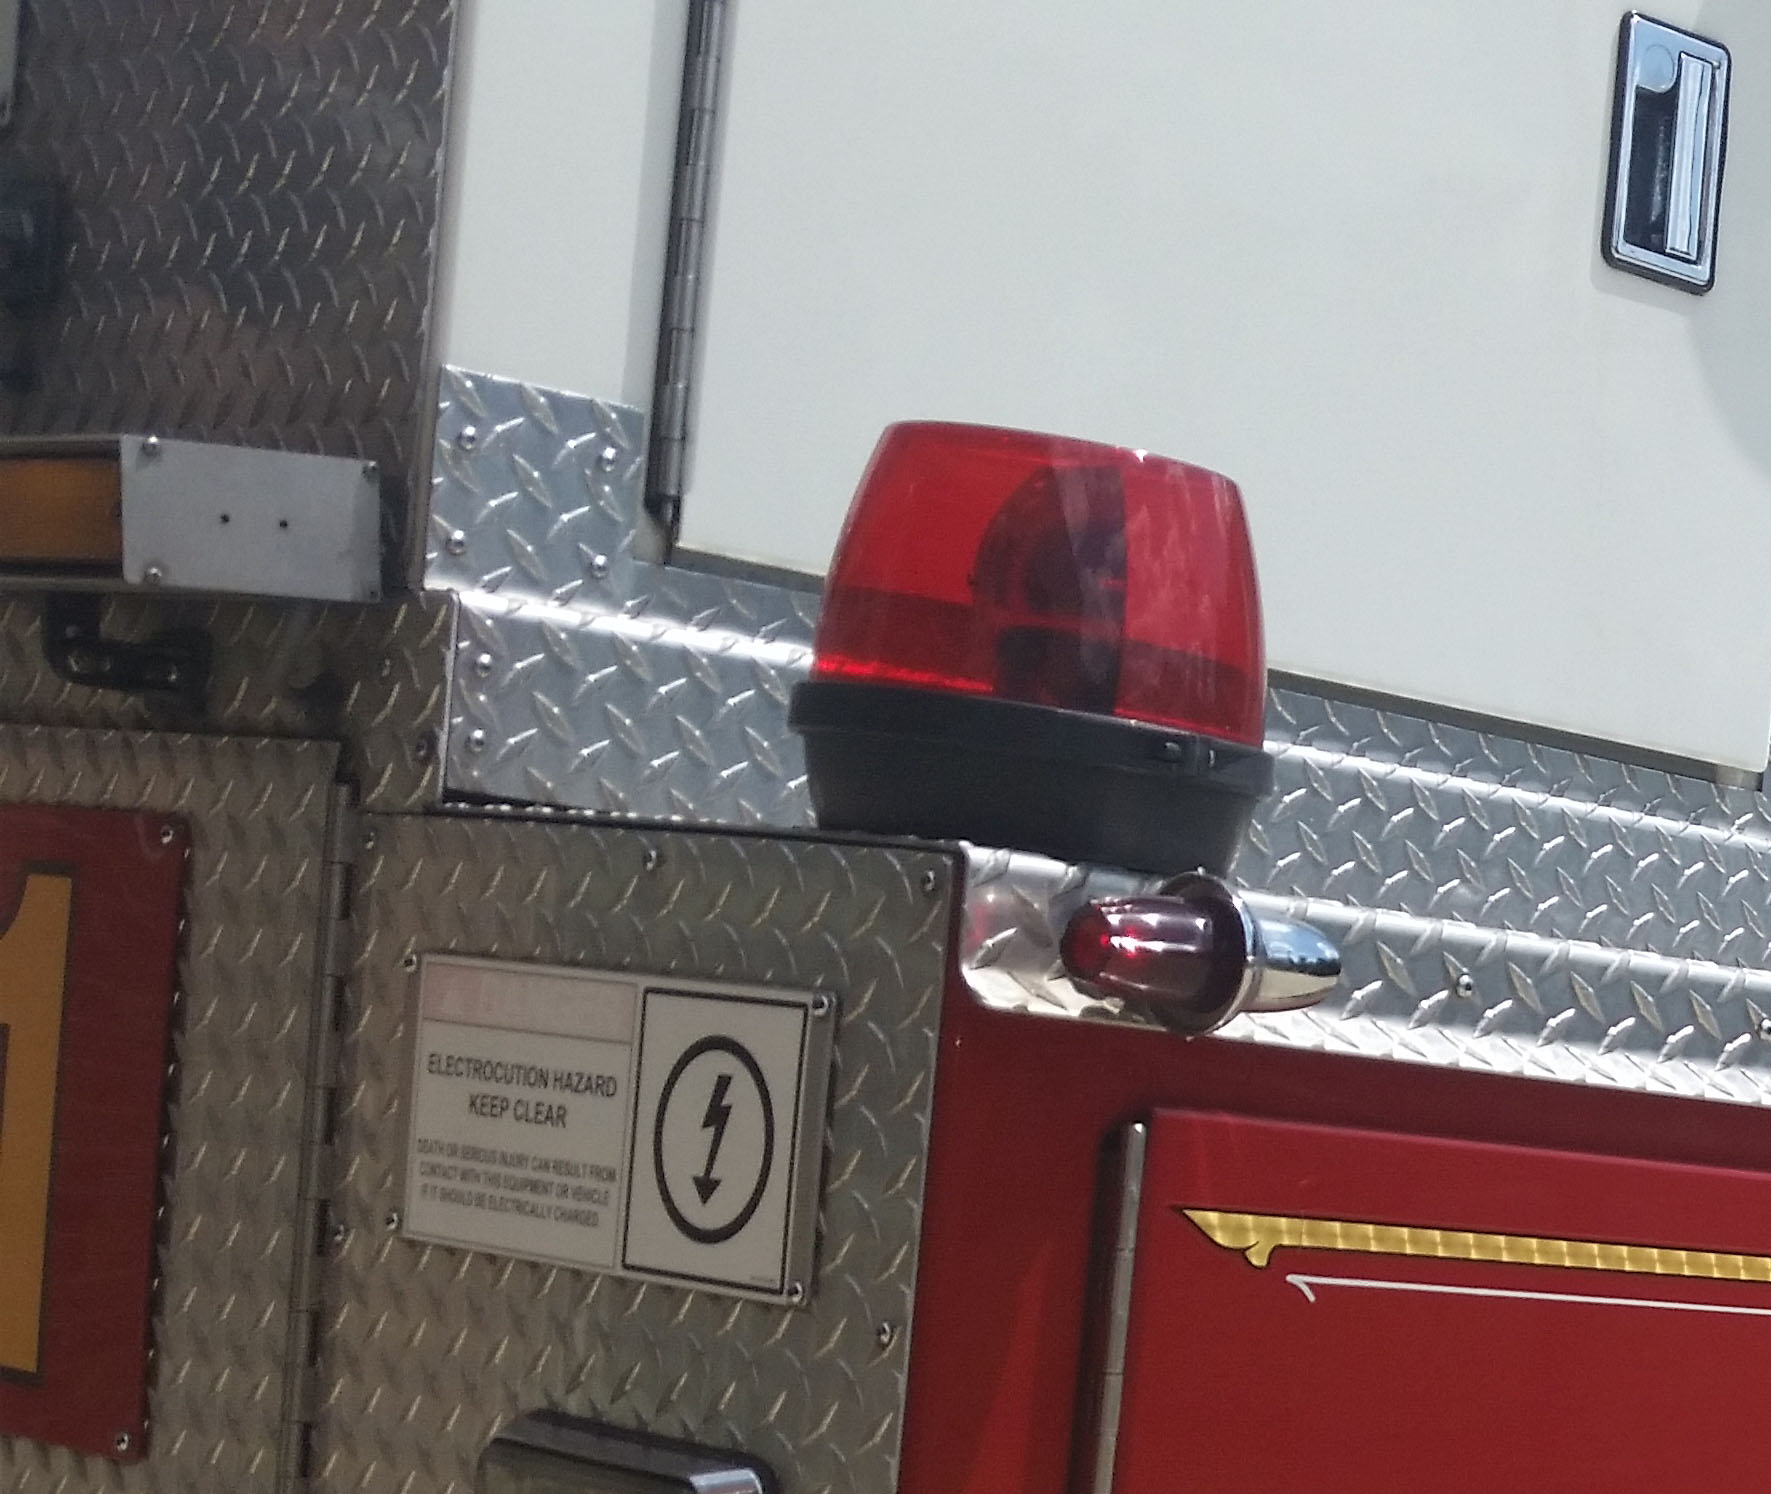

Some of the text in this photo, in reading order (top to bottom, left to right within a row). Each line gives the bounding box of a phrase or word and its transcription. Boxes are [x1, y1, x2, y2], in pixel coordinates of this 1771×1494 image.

[427, 1053, 618, 1097] ELECTROCUTION HAZARD
[468, 1093, 567, 1128] KEEP CLEAR
